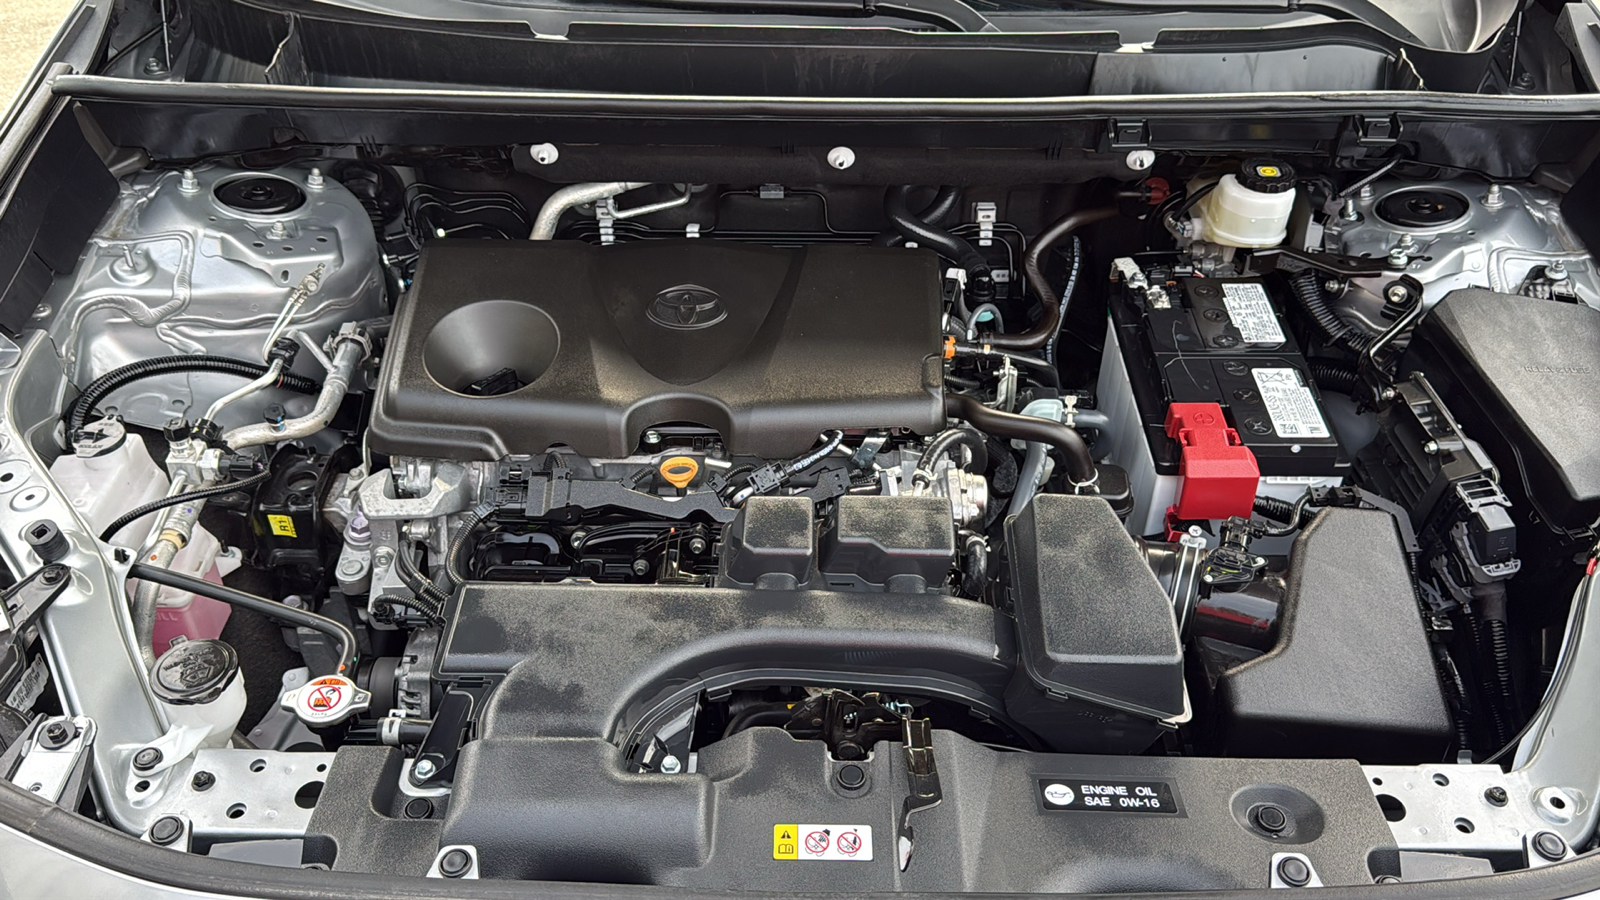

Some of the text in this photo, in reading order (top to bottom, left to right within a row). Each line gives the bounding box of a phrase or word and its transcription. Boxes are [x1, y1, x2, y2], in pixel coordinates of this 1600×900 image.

[1081, 784, 1158, 797] ENGINE OIL
[1084, 796, 1160, 808] SAE 0W-16
